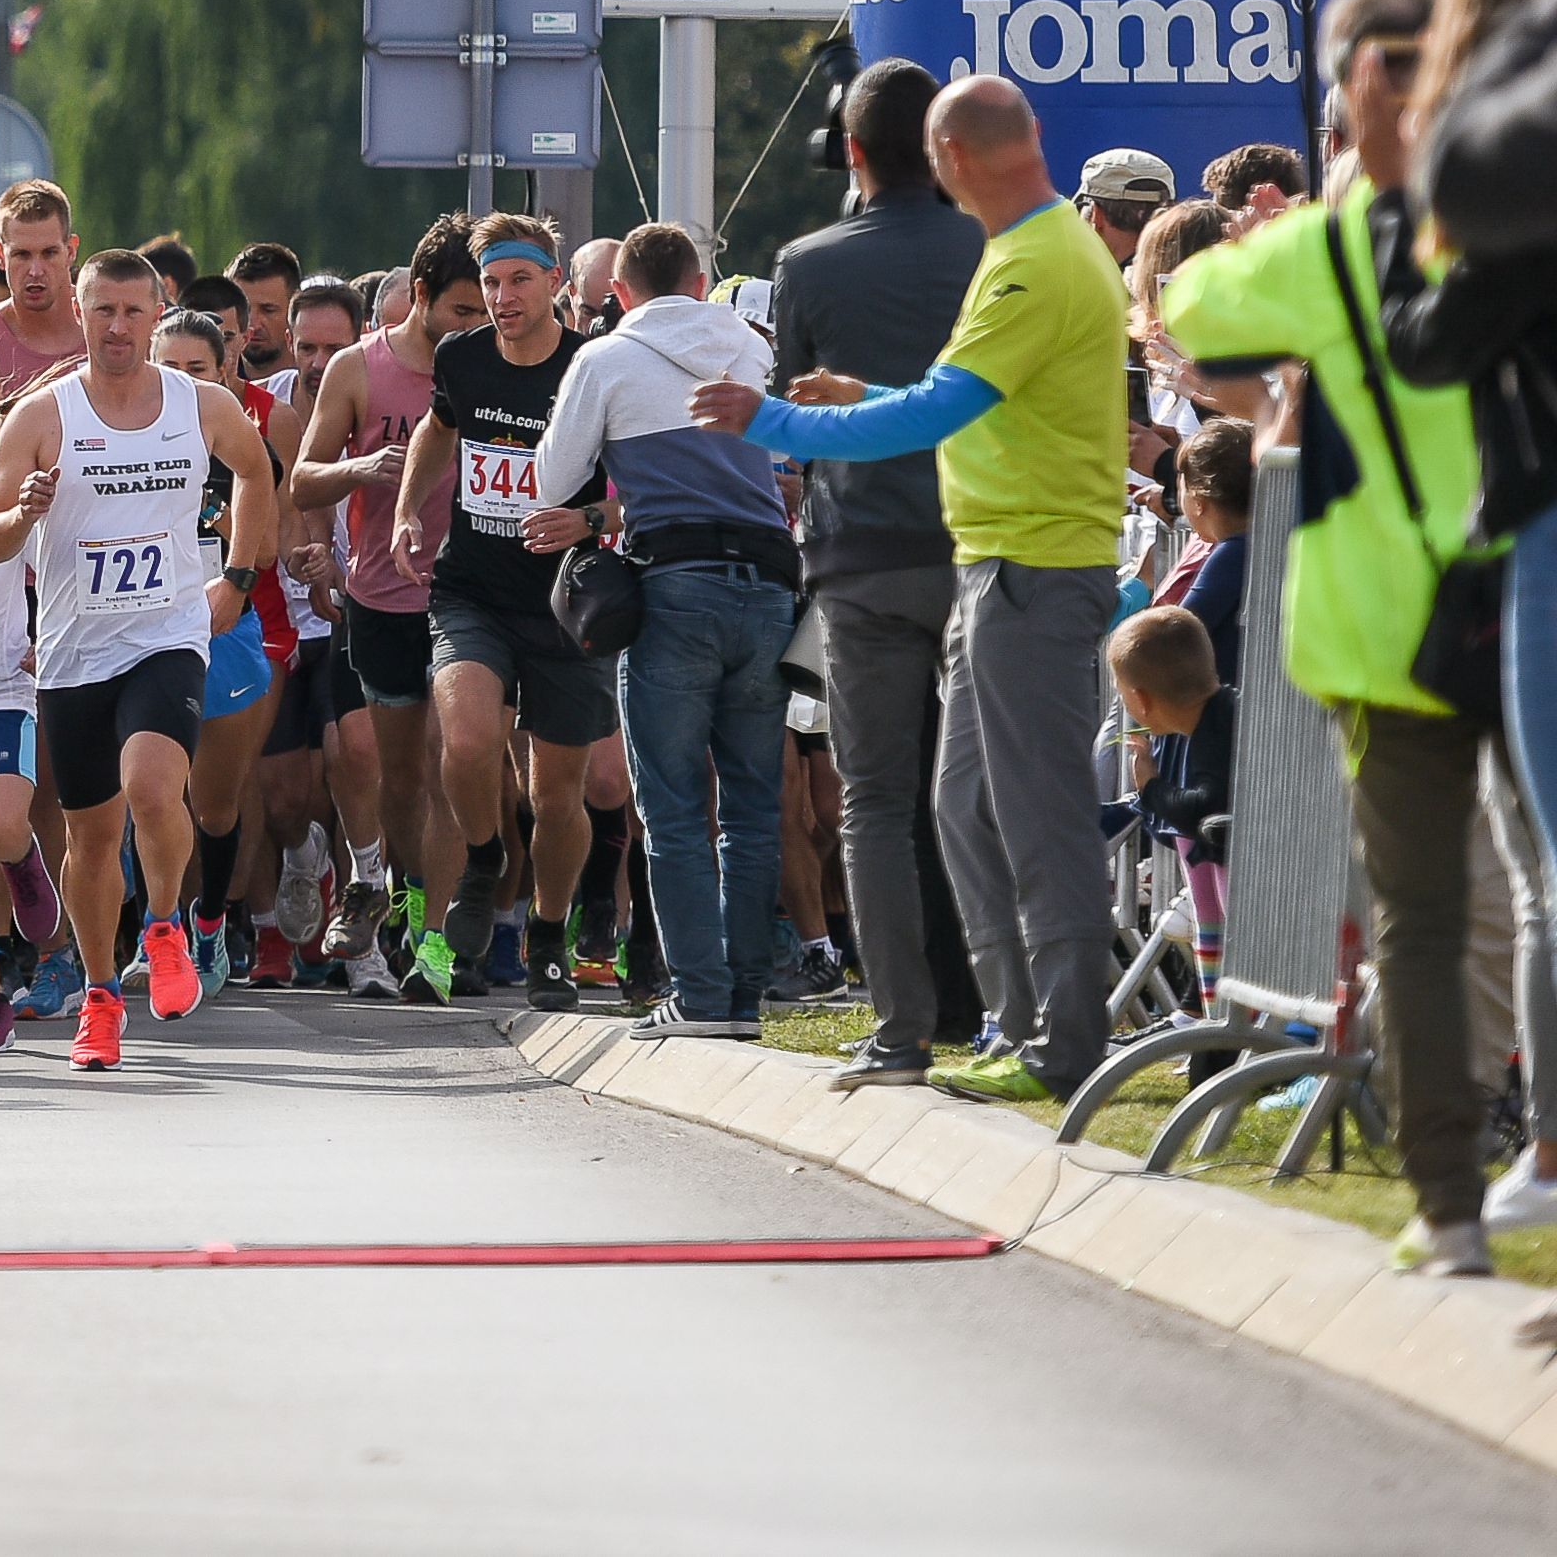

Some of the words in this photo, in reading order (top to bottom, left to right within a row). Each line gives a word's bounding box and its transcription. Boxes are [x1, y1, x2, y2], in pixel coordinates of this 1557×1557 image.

[475, 406, 546, 431] utrka.com
[82, 463, 150, 476] ATLETSKI
[154, 459, 192, 472] KLUB
[469, 453, 537, 500] 344
[93, 476, 187, 495] VARAŽDIN
[85, 545, 163, 594] 722
